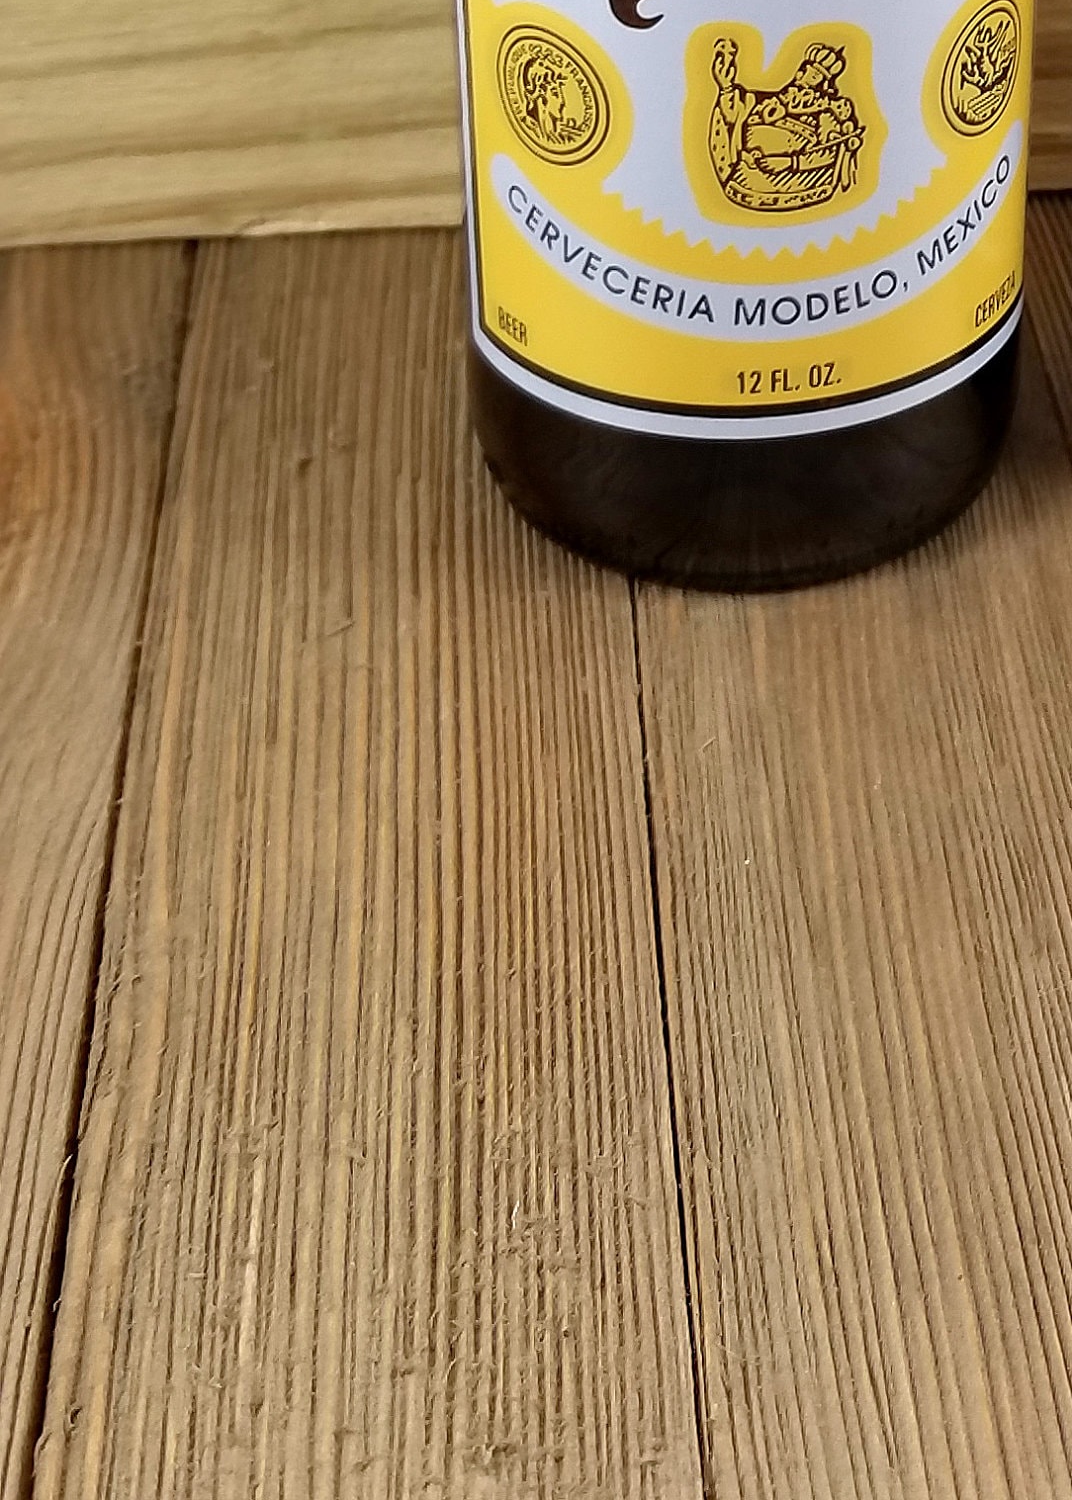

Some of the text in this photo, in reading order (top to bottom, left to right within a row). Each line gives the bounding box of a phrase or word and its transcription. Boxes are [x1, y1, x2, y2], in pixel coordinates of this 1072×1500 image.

[507, 153, 1012, 327] CERVECERIA MODELO, MEXICO
[497, 305, 529, 347] BEER
[737, 361, 842, 395] 12 FL. OZ.
